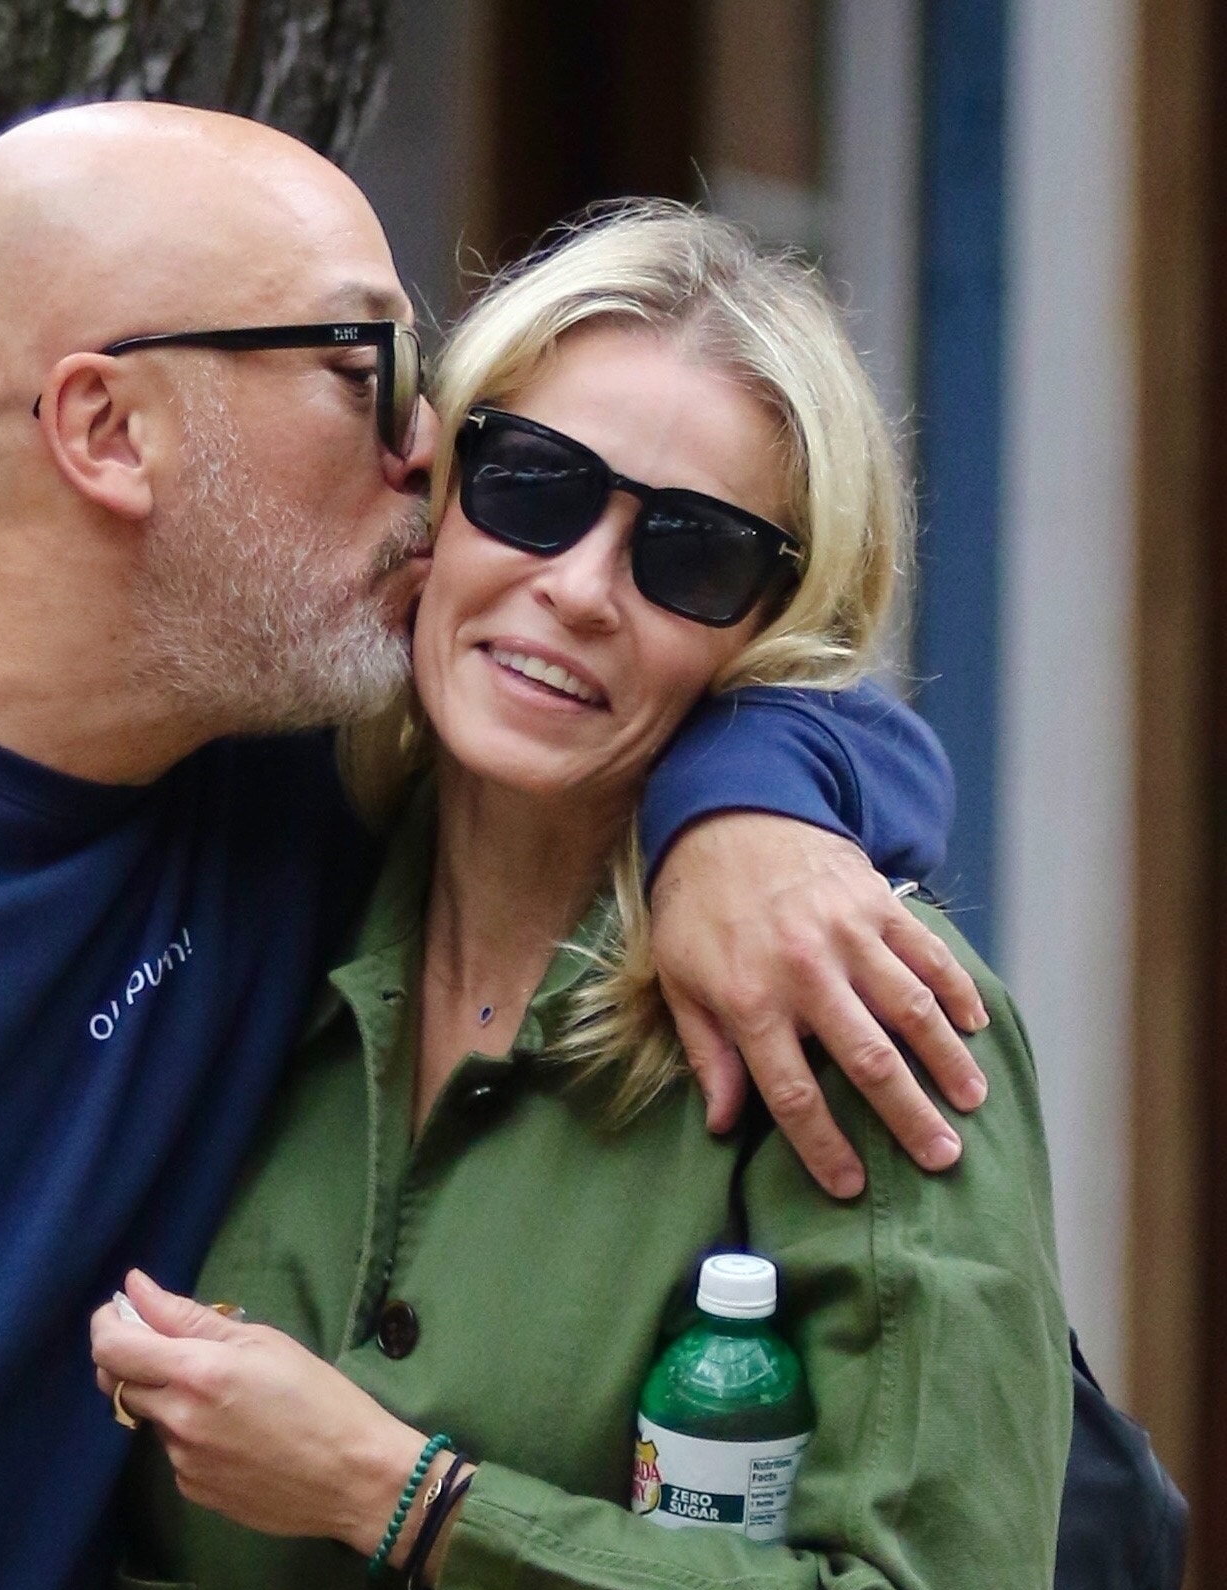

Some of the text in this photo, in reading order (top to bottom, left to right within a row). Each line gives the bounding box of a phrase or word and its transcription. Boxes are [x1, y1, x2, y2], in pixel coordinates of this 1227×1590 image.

[751, 1471, 778, 1482] Facts
[670, 1487, 713, 1507] ZERO
[668, 1500, 720, 1521] SUGAR
